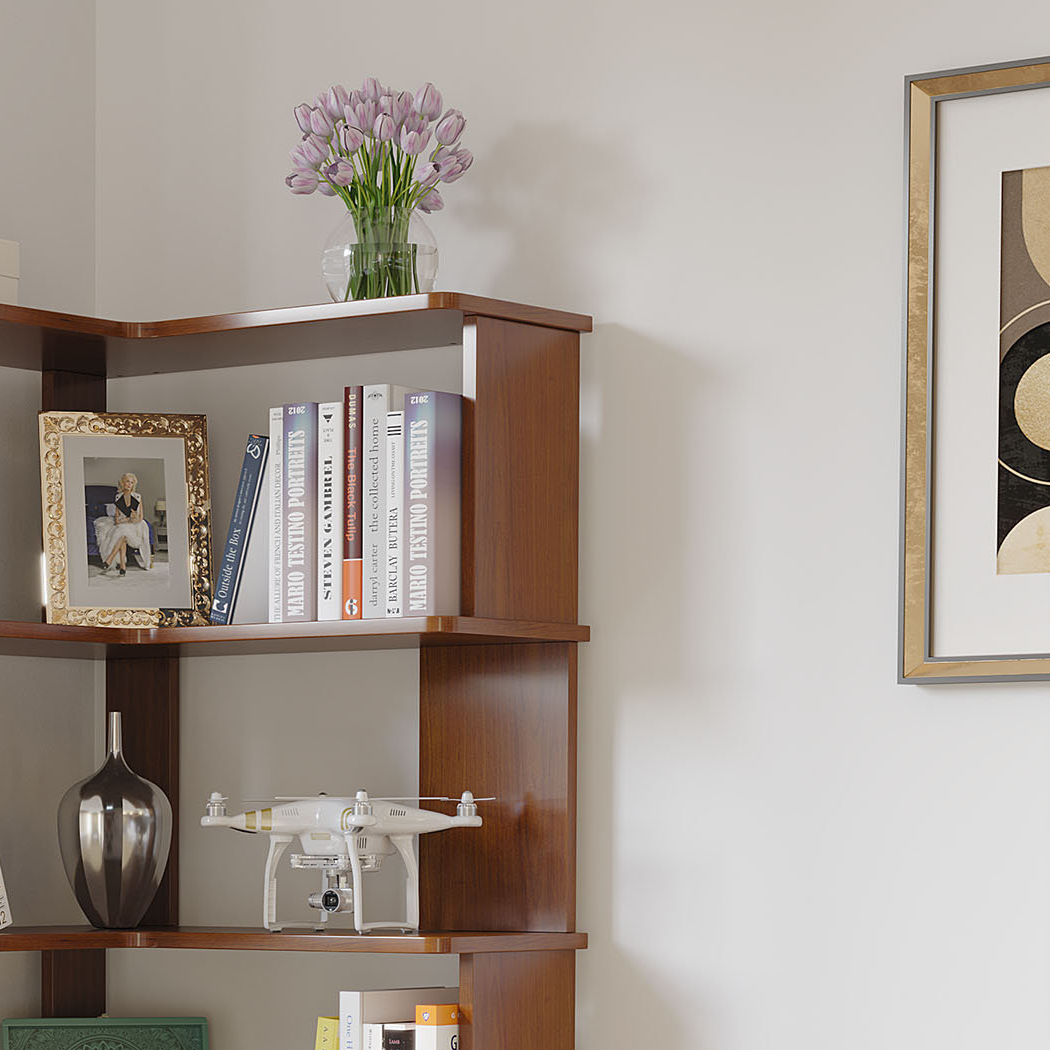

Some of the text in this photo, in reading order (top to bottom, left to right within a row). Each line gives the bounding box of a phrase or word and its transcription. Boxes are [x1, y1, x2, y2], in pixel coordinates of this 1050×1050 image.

[288, 405, 306, 415] 2012
[348, 394, 356, 429] DUMAS
[410, 395, 429, 405] 2012
[346, 447, 356, 541] The Black Tulip
[369, 418, 379, 532] the collected home
[230, 528, 242, 545] Box
[287, 511, 305, 567] TESTINO
[323, 455, 333, 600] STEVEN GAMBREL
[388, 507, 398, 549] BUTERA
[409, 504, 428, 560] TESTINO
[227, 547, 238, 562] the
[274, 566, 281, 577] OF
[218, 565, 235, 598] Outside
[273, 578, 281, 605] ALLURE
[369, 543, 380, 606] darryl carter
[388, 555, 398, 602] BARCLAY
[409, 565, 428, 611] MARIO
[287, 571, 305, 617] MARIO
[273, 606, 281, 621] THE
[345, 1015, 353, 1035] One
